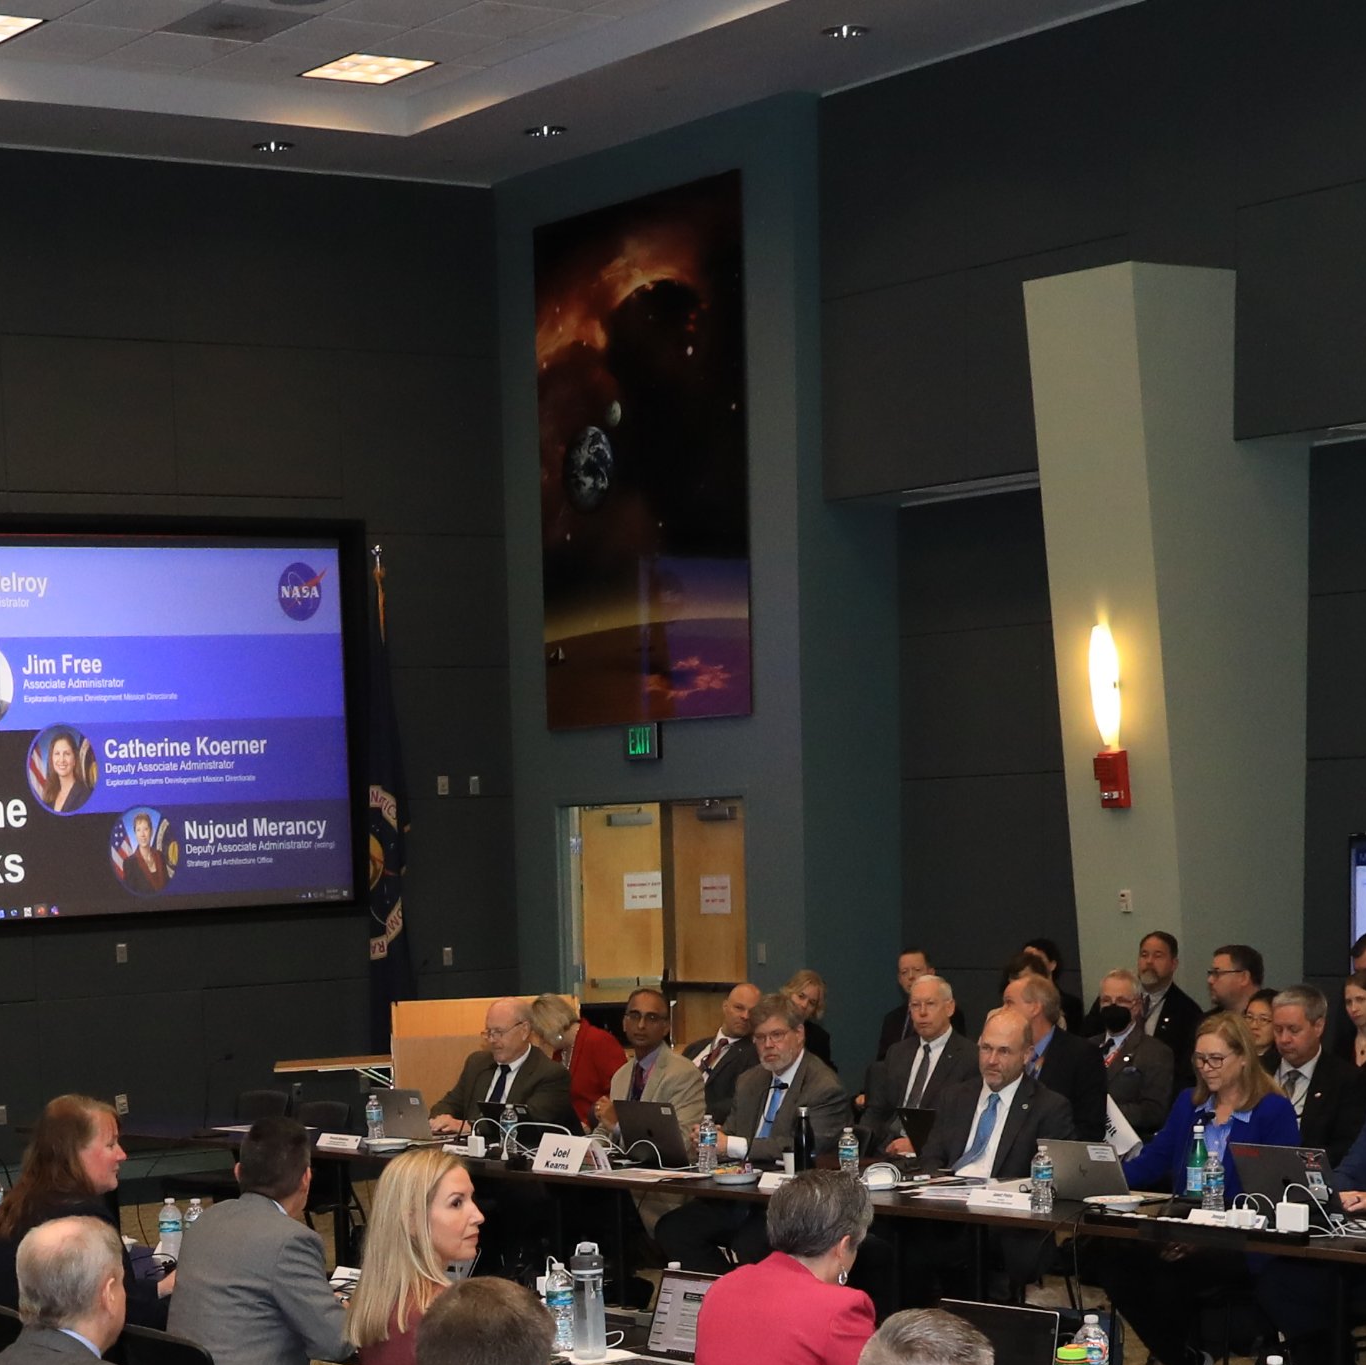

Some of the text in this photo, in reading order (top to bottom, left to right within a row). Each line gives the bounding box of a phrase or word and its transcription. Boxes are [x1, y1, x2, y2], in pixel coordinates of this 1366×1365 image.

[281, 586, 319, 598] NASA
[22, 654, 102, 674] Jim Free
[23, 678, 124, 689] Associate Administrator
[105, 737, 267, 758] Catherine Koerner
[628, 727, 651, 754] EXIT
[105, 760, 235, 774] Deputy Associate Administrator
[185, 818, 326, 843] Nujoud Merancy
[186, 844, 215, 855] Deputy
[217, 842, 257, 852] Associate
[259, 840, 312, 850] Administrator
[553, 1147, 570, 1158] Joel
[545, 1161, 569, 1170] Kearns
